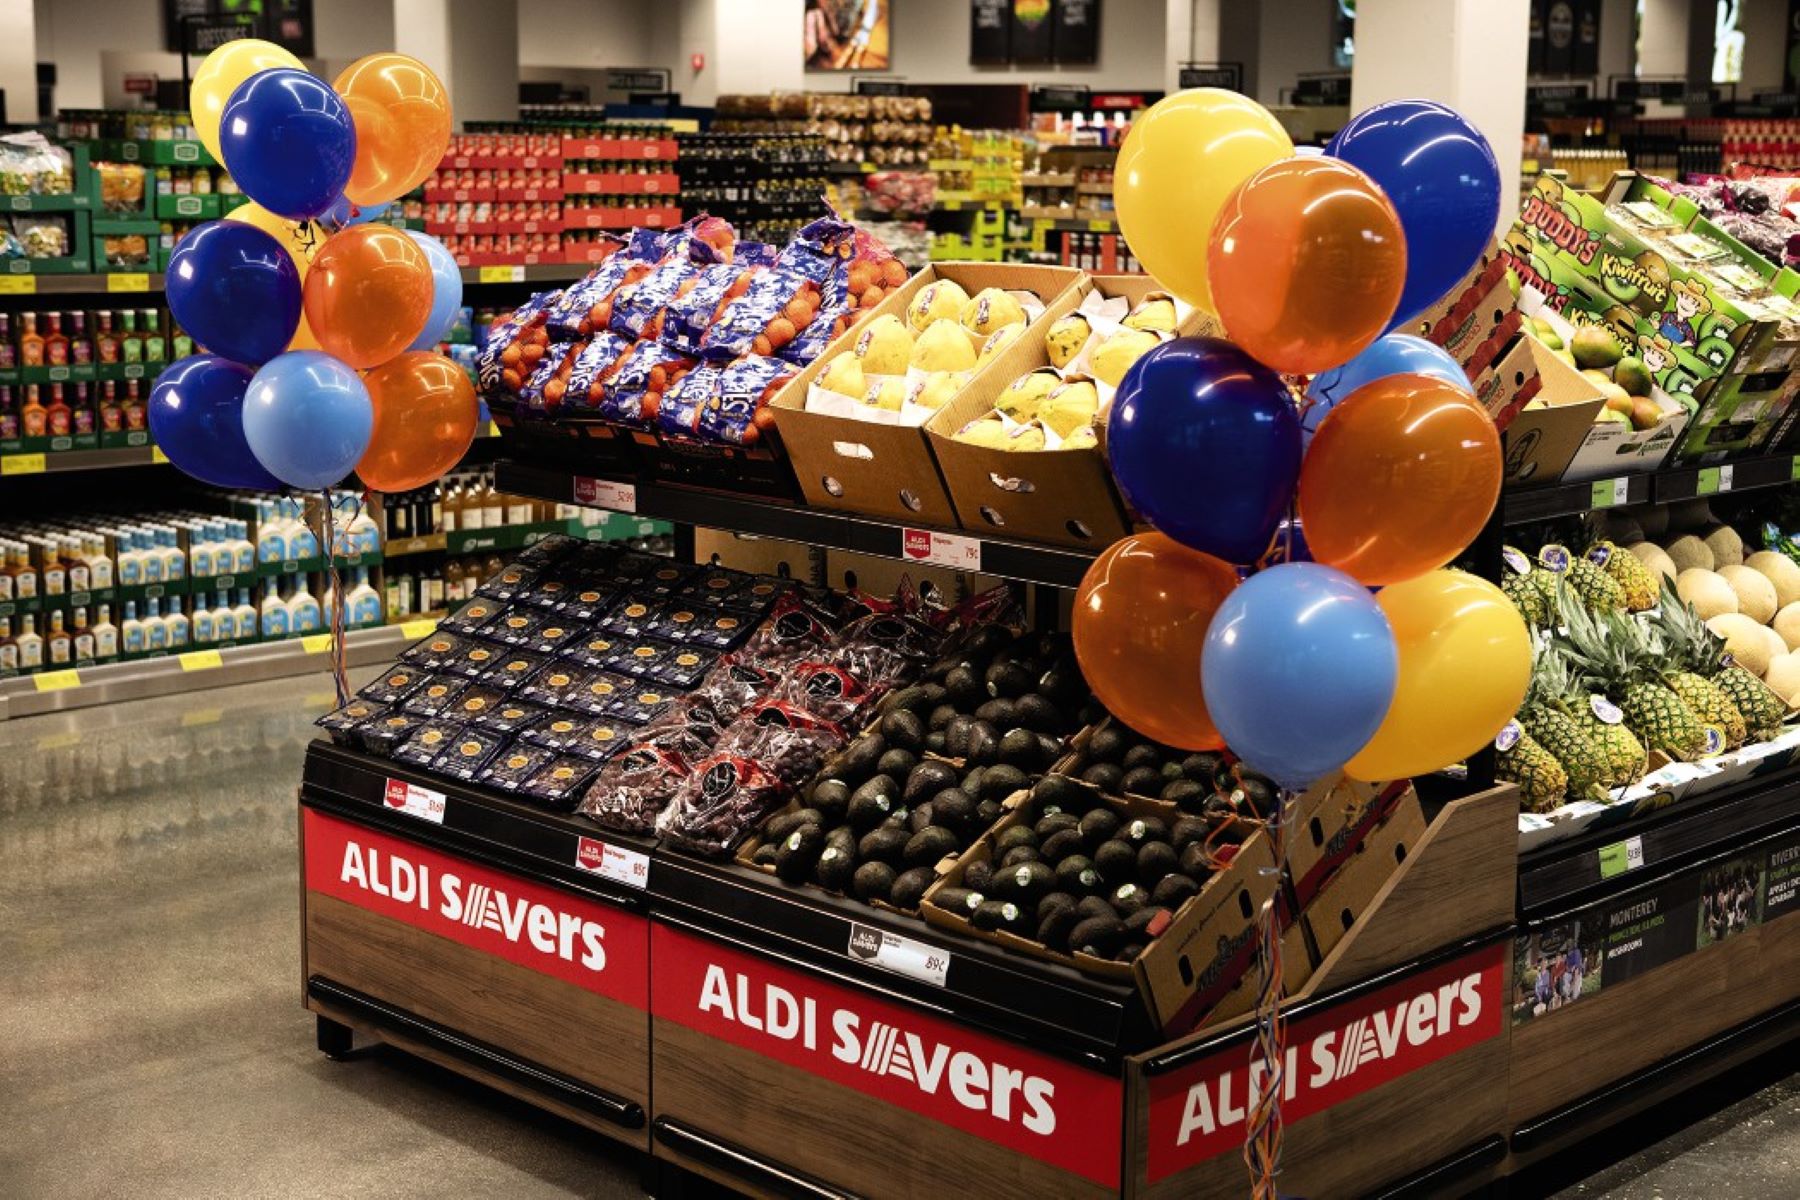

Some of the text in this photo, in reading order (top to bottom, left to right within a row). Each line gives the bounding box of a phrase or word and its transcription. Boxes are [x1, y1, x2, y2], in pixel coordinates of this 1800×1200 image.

[1520, 196, 1601, 265] BUDDY'S
[1601, 253, 1667, 303] Kiwifruit
[341, 841, 429, 911] ALDI
[1609, 897, 1658, 928] MONTEREY
[699, 964, 817, 1051] ALDI
[1177, 1045, 1298, 1146] ALDI
